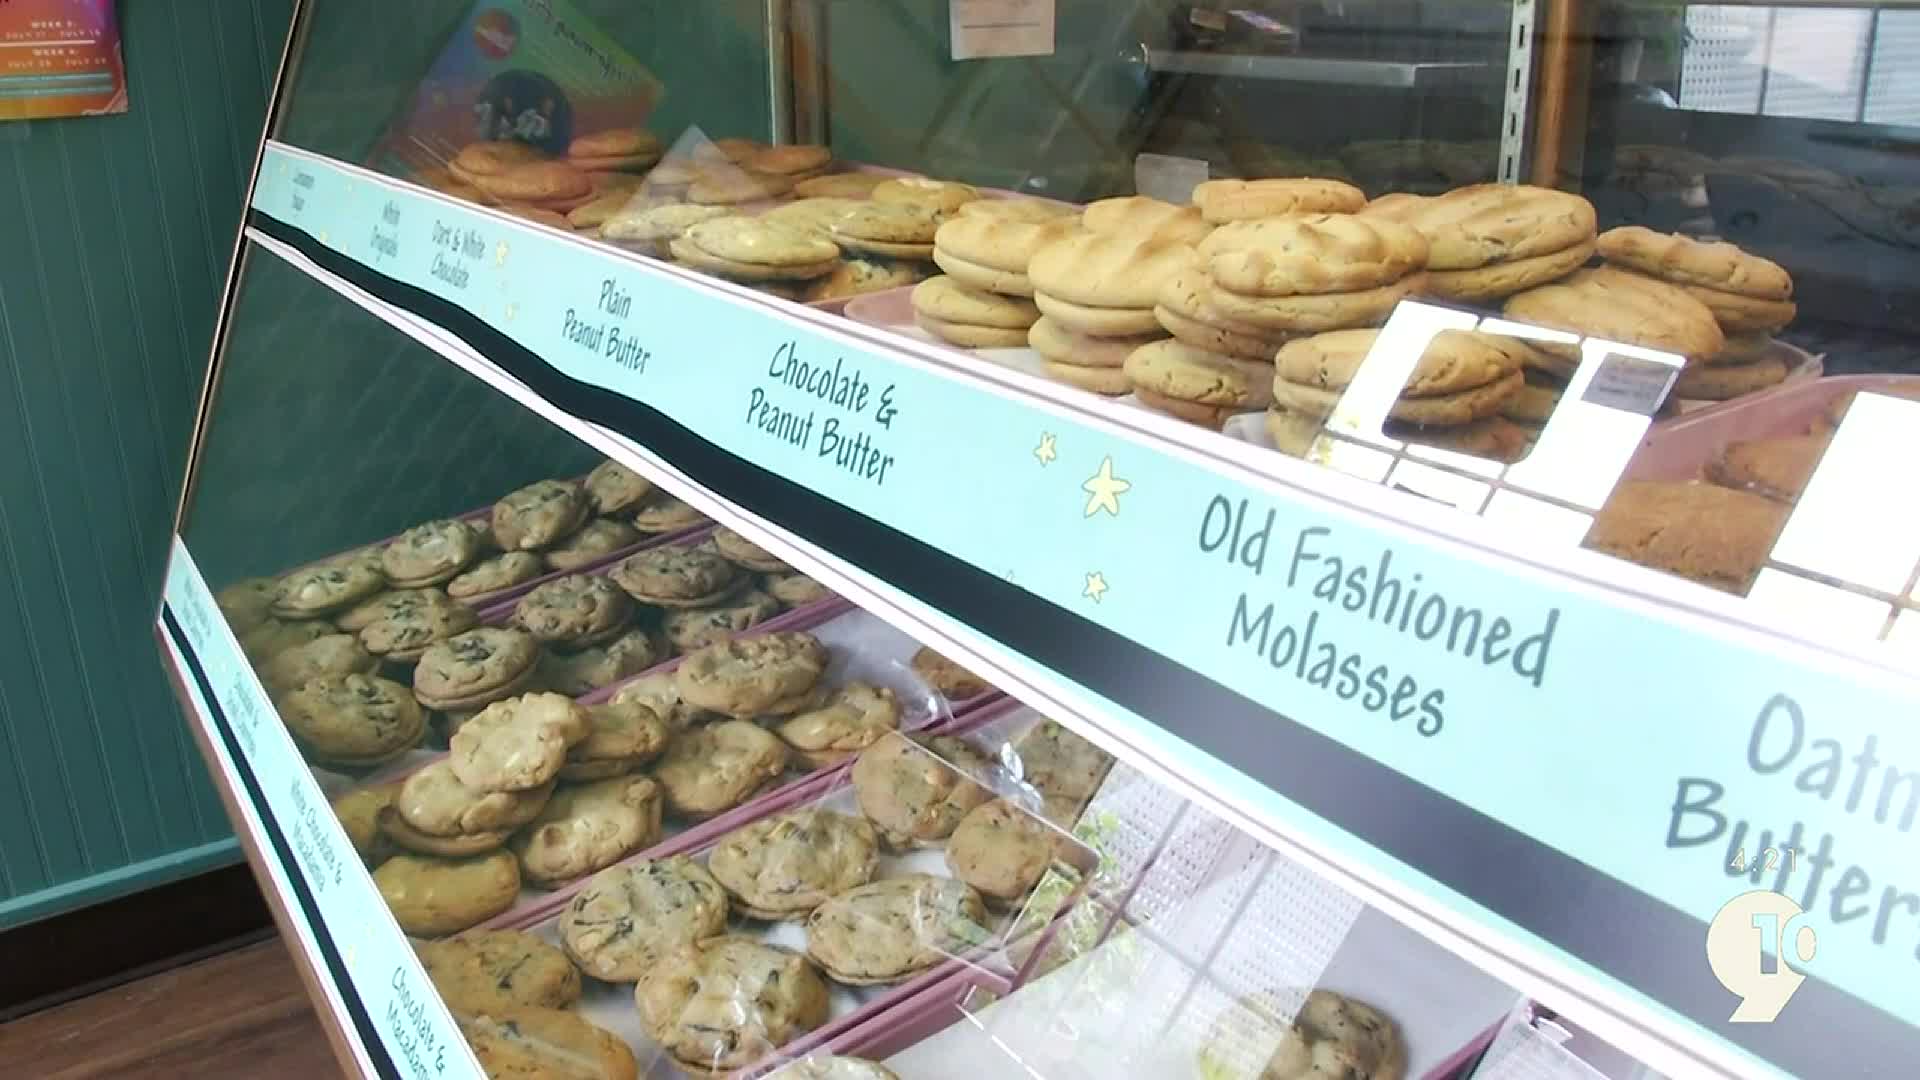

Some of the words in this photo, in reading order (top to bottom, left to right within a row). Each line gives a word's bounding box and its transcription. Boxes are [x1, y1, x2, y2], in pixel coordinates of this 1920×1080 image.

[562, 308, 605, 353] Peanut
[605, 327, 651, 374] Butter
[599, 277, 632, 318] Plain
[768, 340, 870, 413] Chocolate
[875, 384, 898, 430] &
[746, 387, 814, 450] Peanut
[818, 417, 895, 486] Butter
[1199, 493, 1276, 576] Old
[1286, 526, 1561, 689] Fashioned
[1226, 593, 1445, 738] Molasses
[1665, 776, 1920, 963] Butter
[386, 999, 431, 1080] Macadam
[391, 965, 434, 1053] Chocolate
[435, 1044, 446, 1077] &
